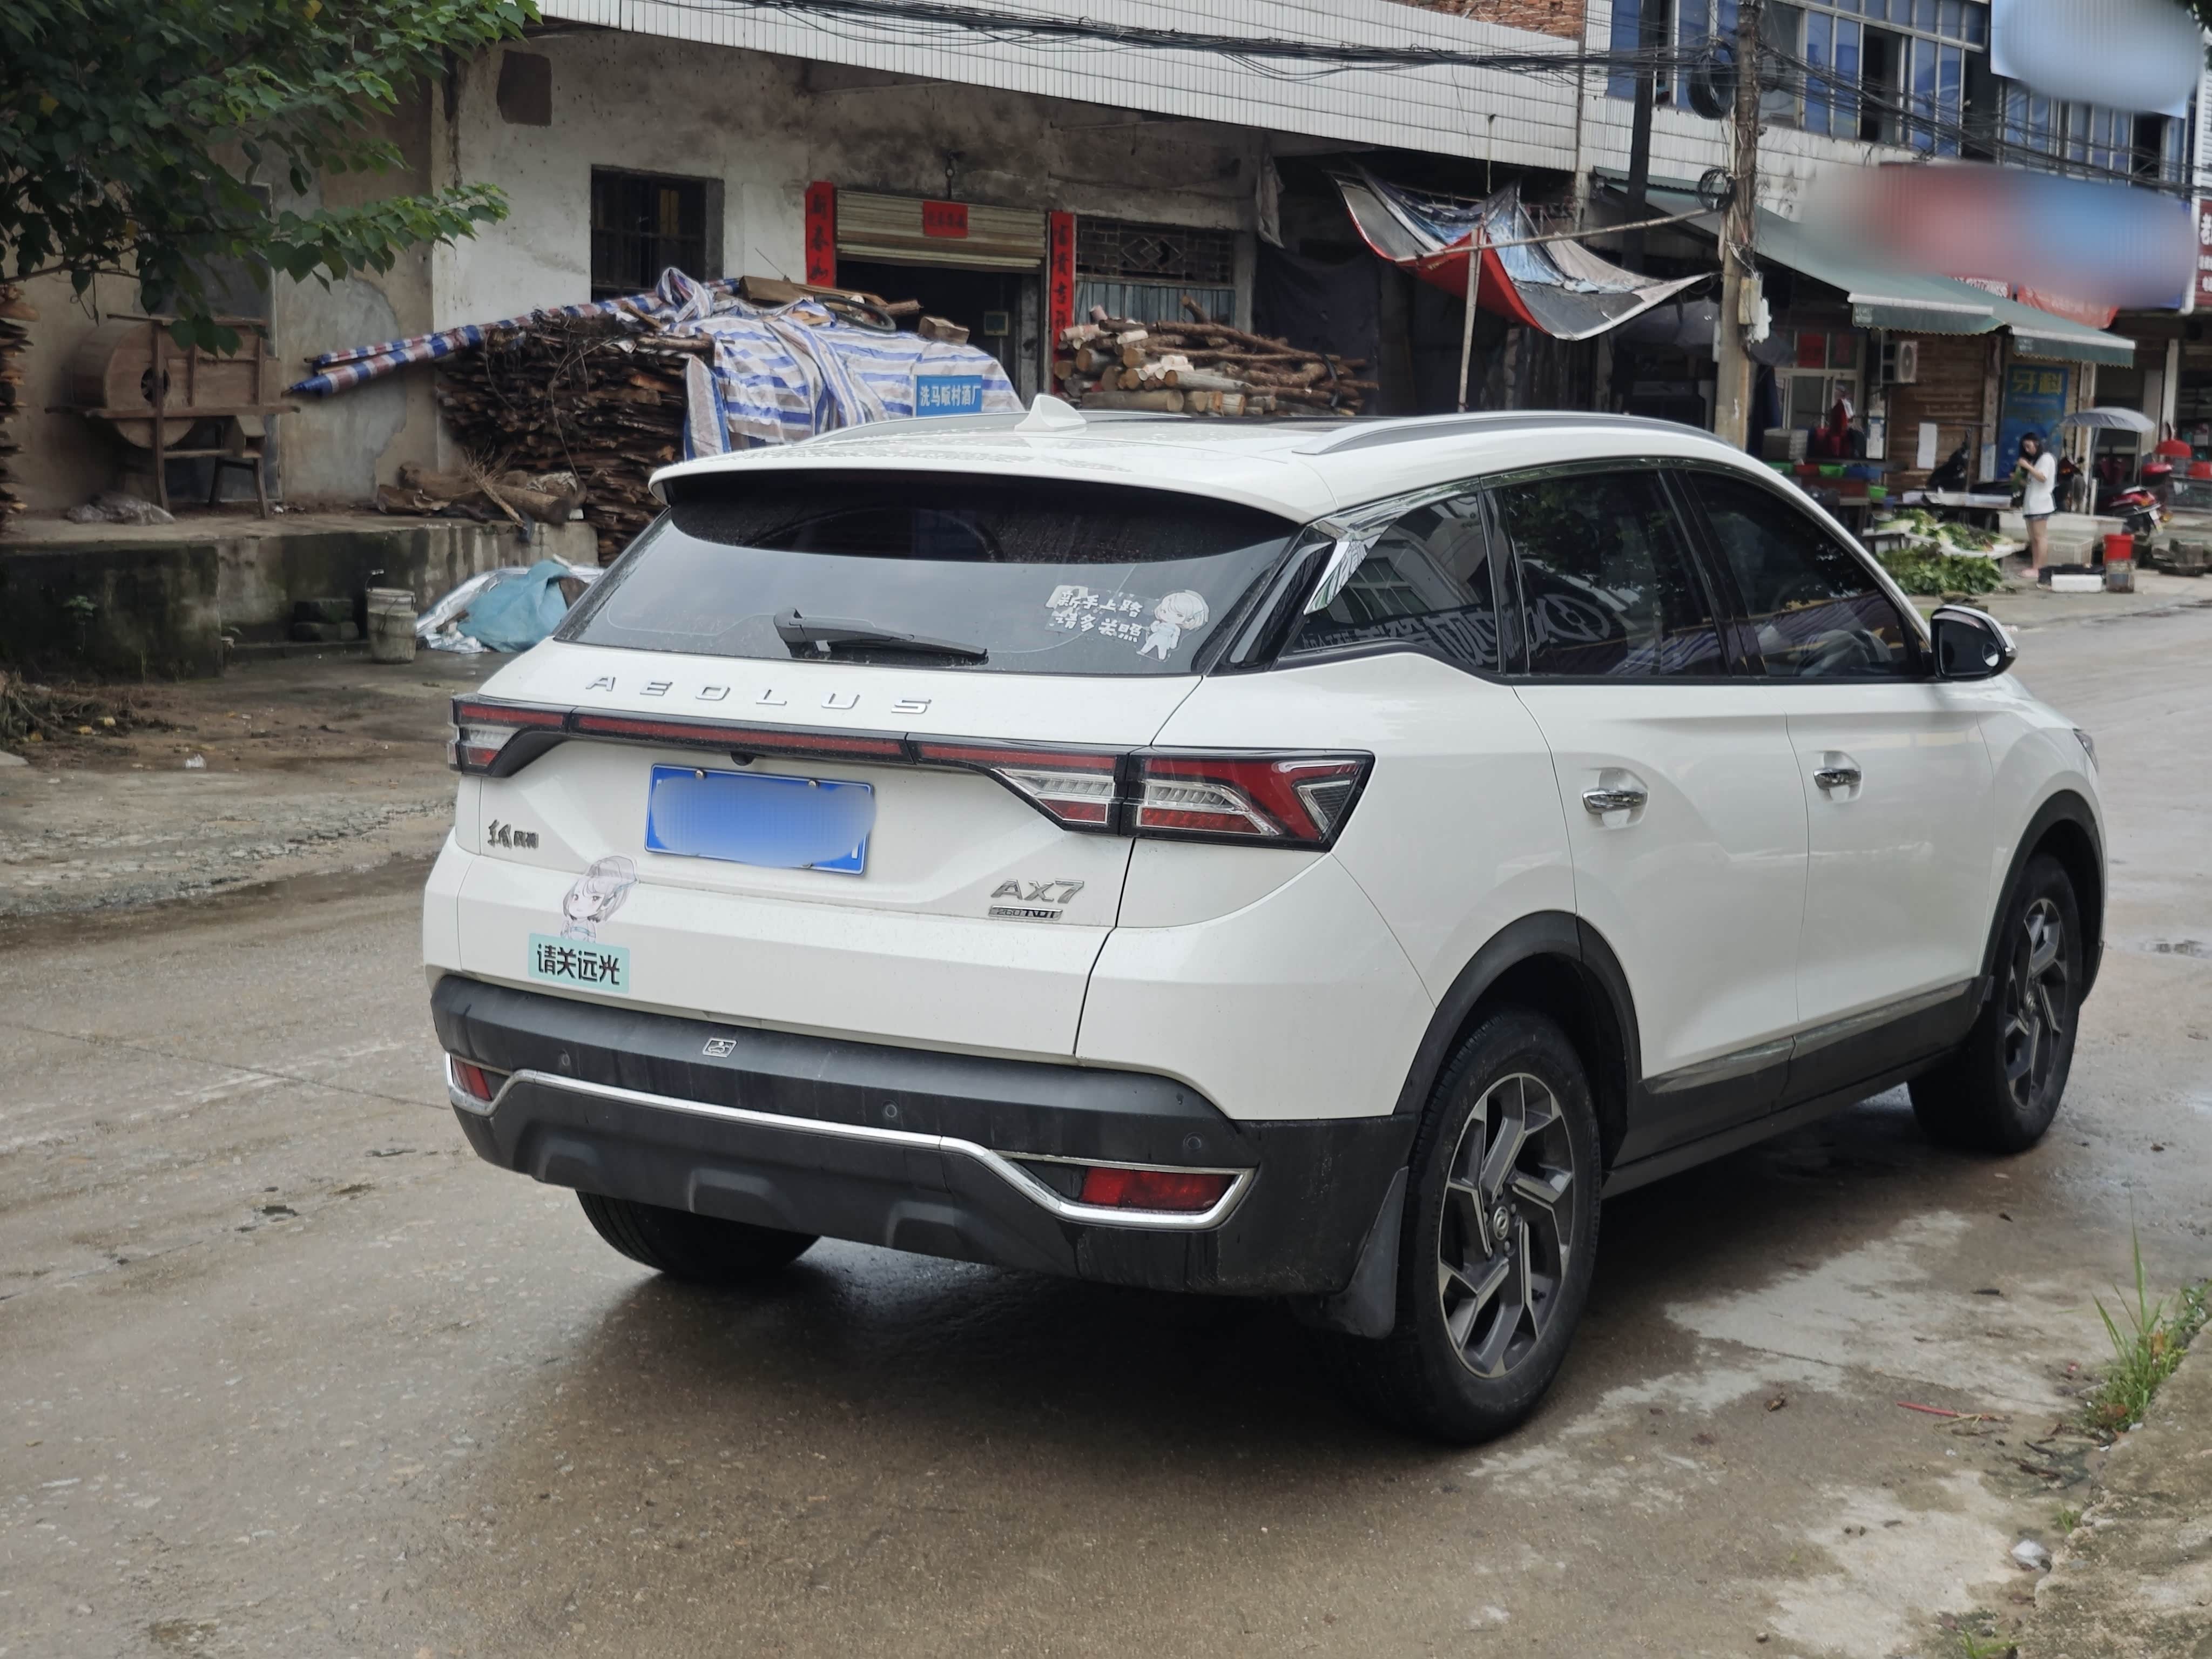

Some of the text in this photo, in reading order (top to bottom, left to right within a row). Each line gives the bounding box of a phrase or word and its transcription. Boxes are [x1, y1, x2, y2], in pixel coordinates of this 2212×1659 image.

[2012, 370, 2063, 395] 牙科
[1057, 590, 1143, 618] 新手上路
[1055, 612, 1143, 643] 请多关照
[585, 676, 932, 714] AEOLUS
[990, 879, 1085, 904] AX7
[537, 943, 621, 986] 请关远光
